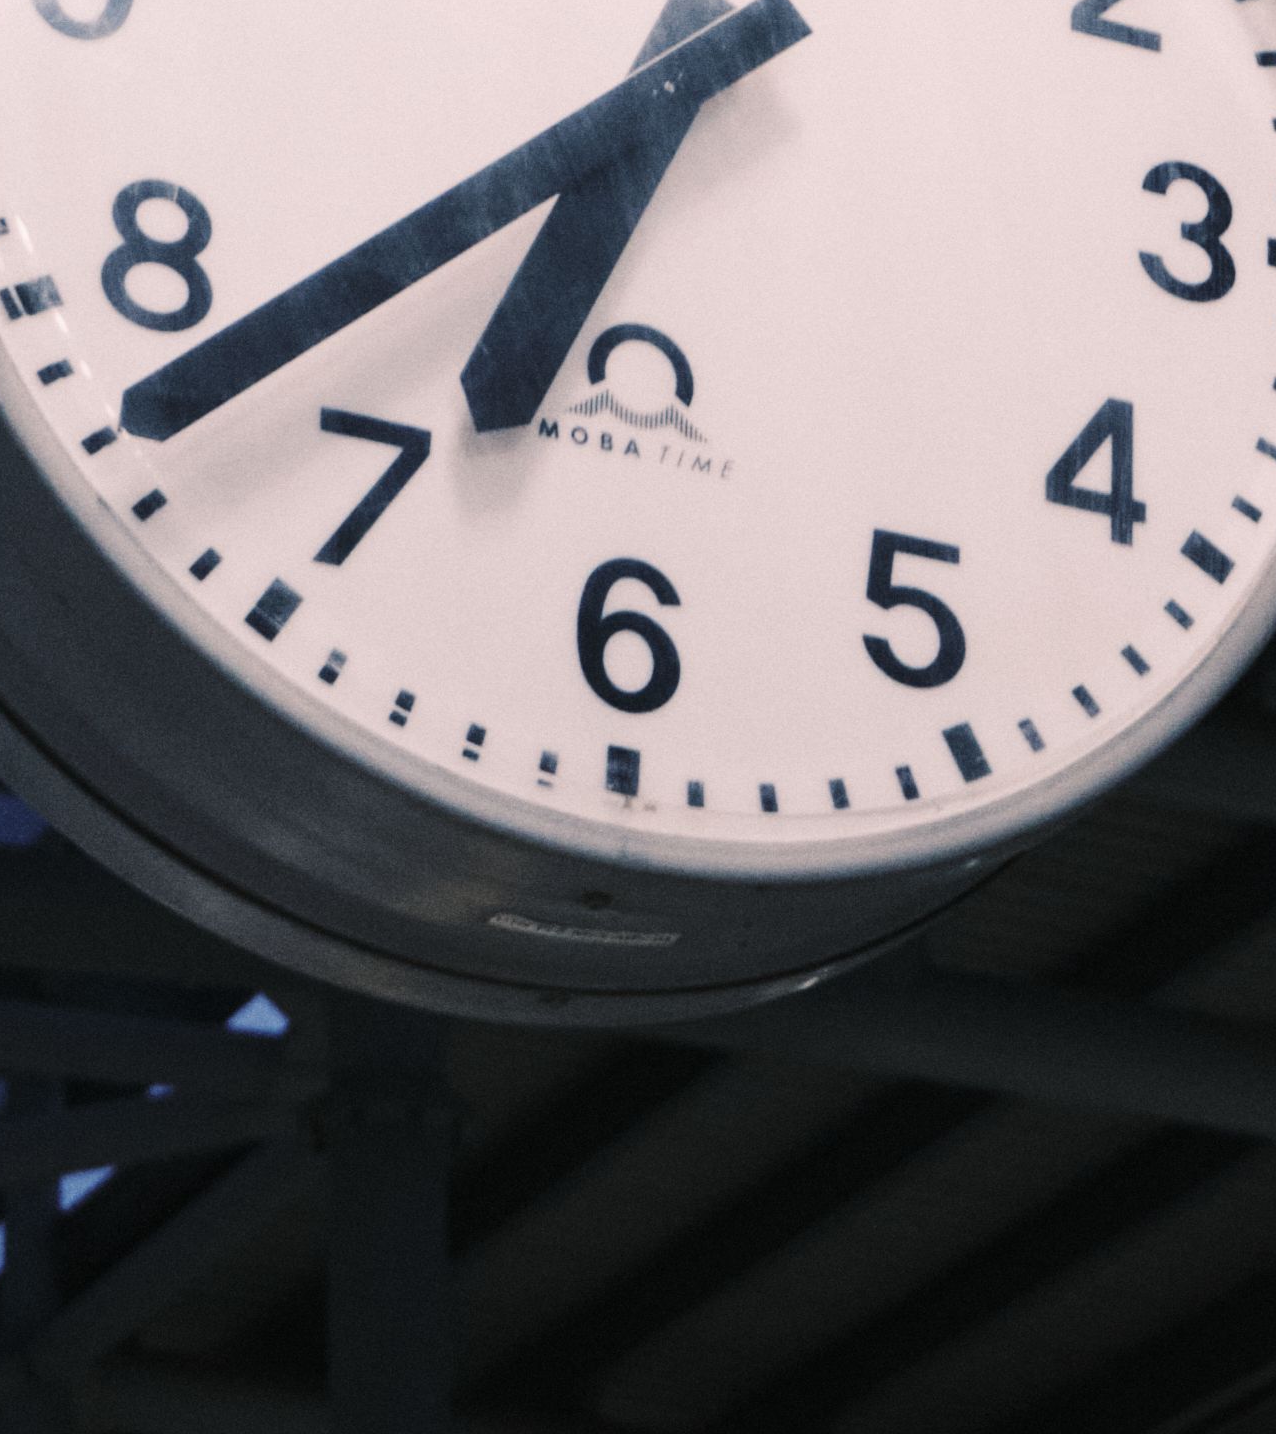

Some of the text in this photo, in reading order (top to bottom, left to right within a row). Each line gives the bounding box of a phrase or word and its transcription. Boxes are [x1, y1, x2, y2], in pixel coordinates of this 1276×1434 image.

[101, 180, 213, 333] 8
[1139, 161, 1236, 304] 3
[315, 407, 431, 566] 7
[538, 418, 735, 478] MOBA TIME
[1045, 399, 1146, 546] 4
[576, 558, 681, 714] 6
[863, 529, 966, 689] 5
